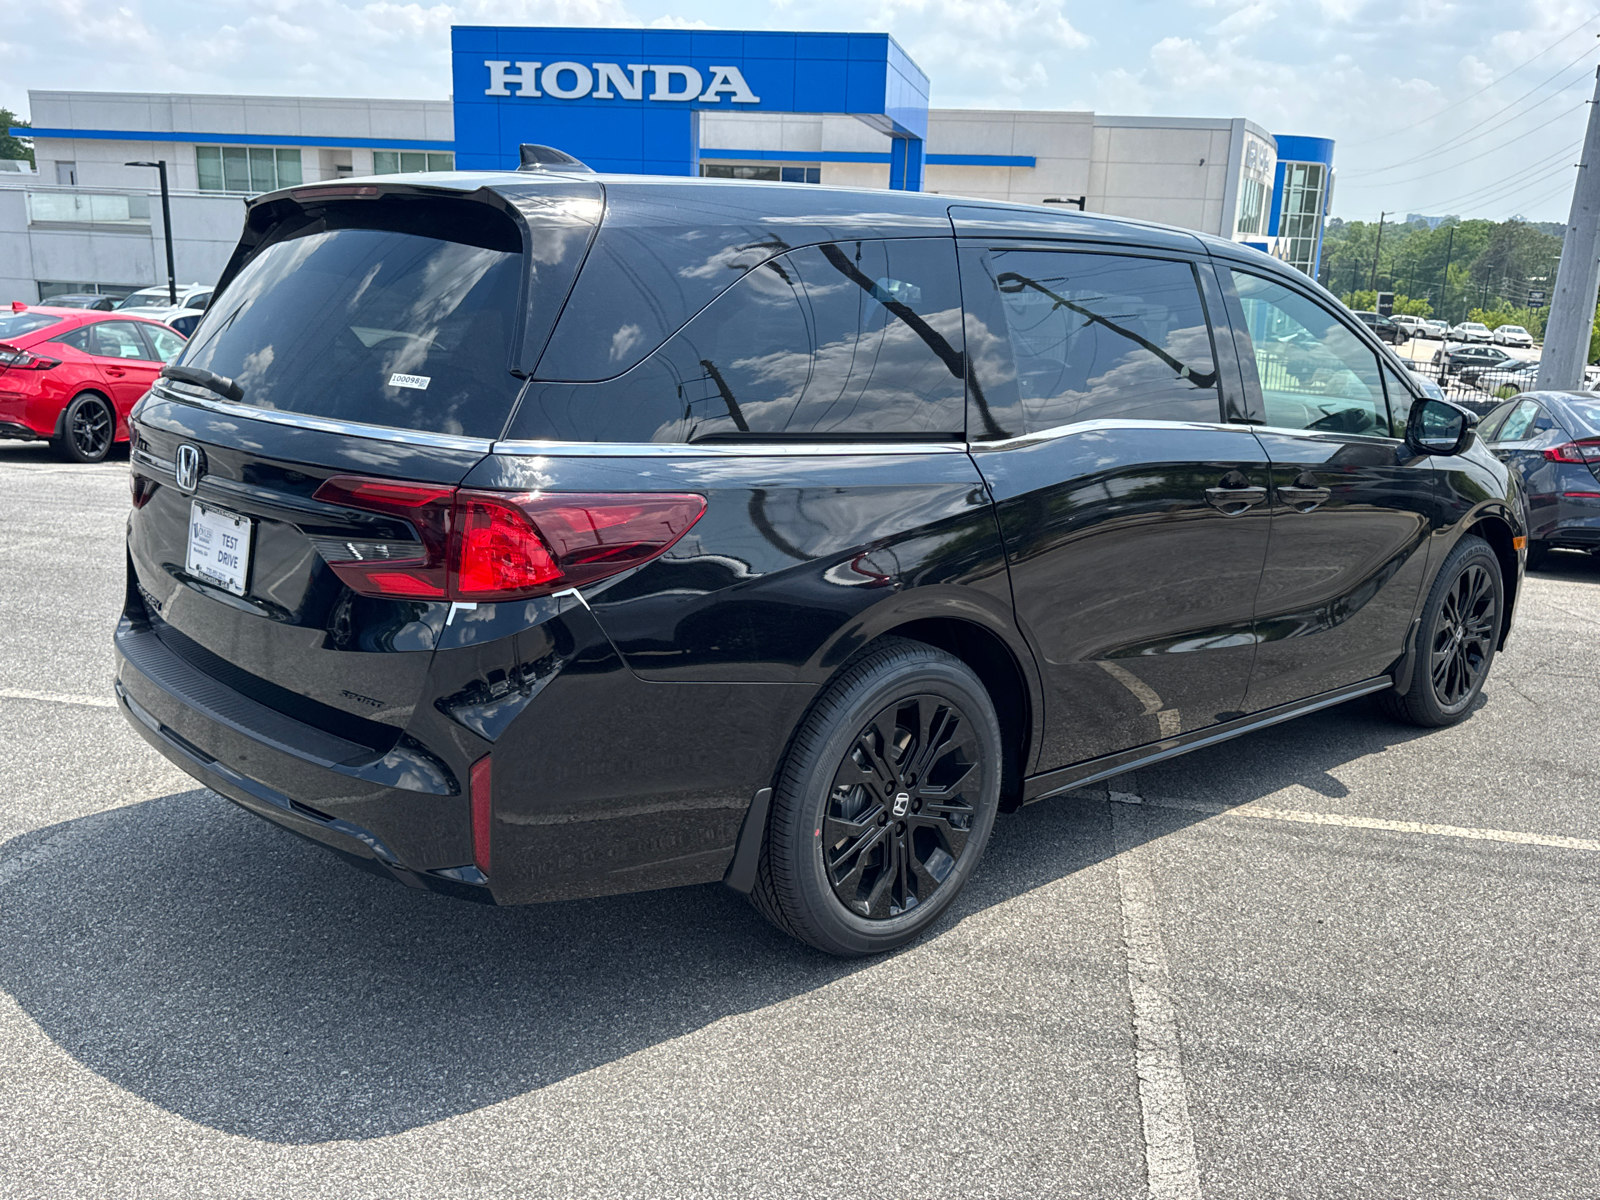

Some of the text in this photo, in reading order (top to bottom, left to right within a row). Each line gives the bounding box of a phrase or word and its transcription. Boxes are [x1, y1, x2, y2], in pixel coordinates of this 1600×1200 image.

[484, 60, 760, 103] HONDA
[392, 375, 420, 385] 100098
[222, 533, 239, 551] TEST
[217, 550, 239, 569] DRIVE
